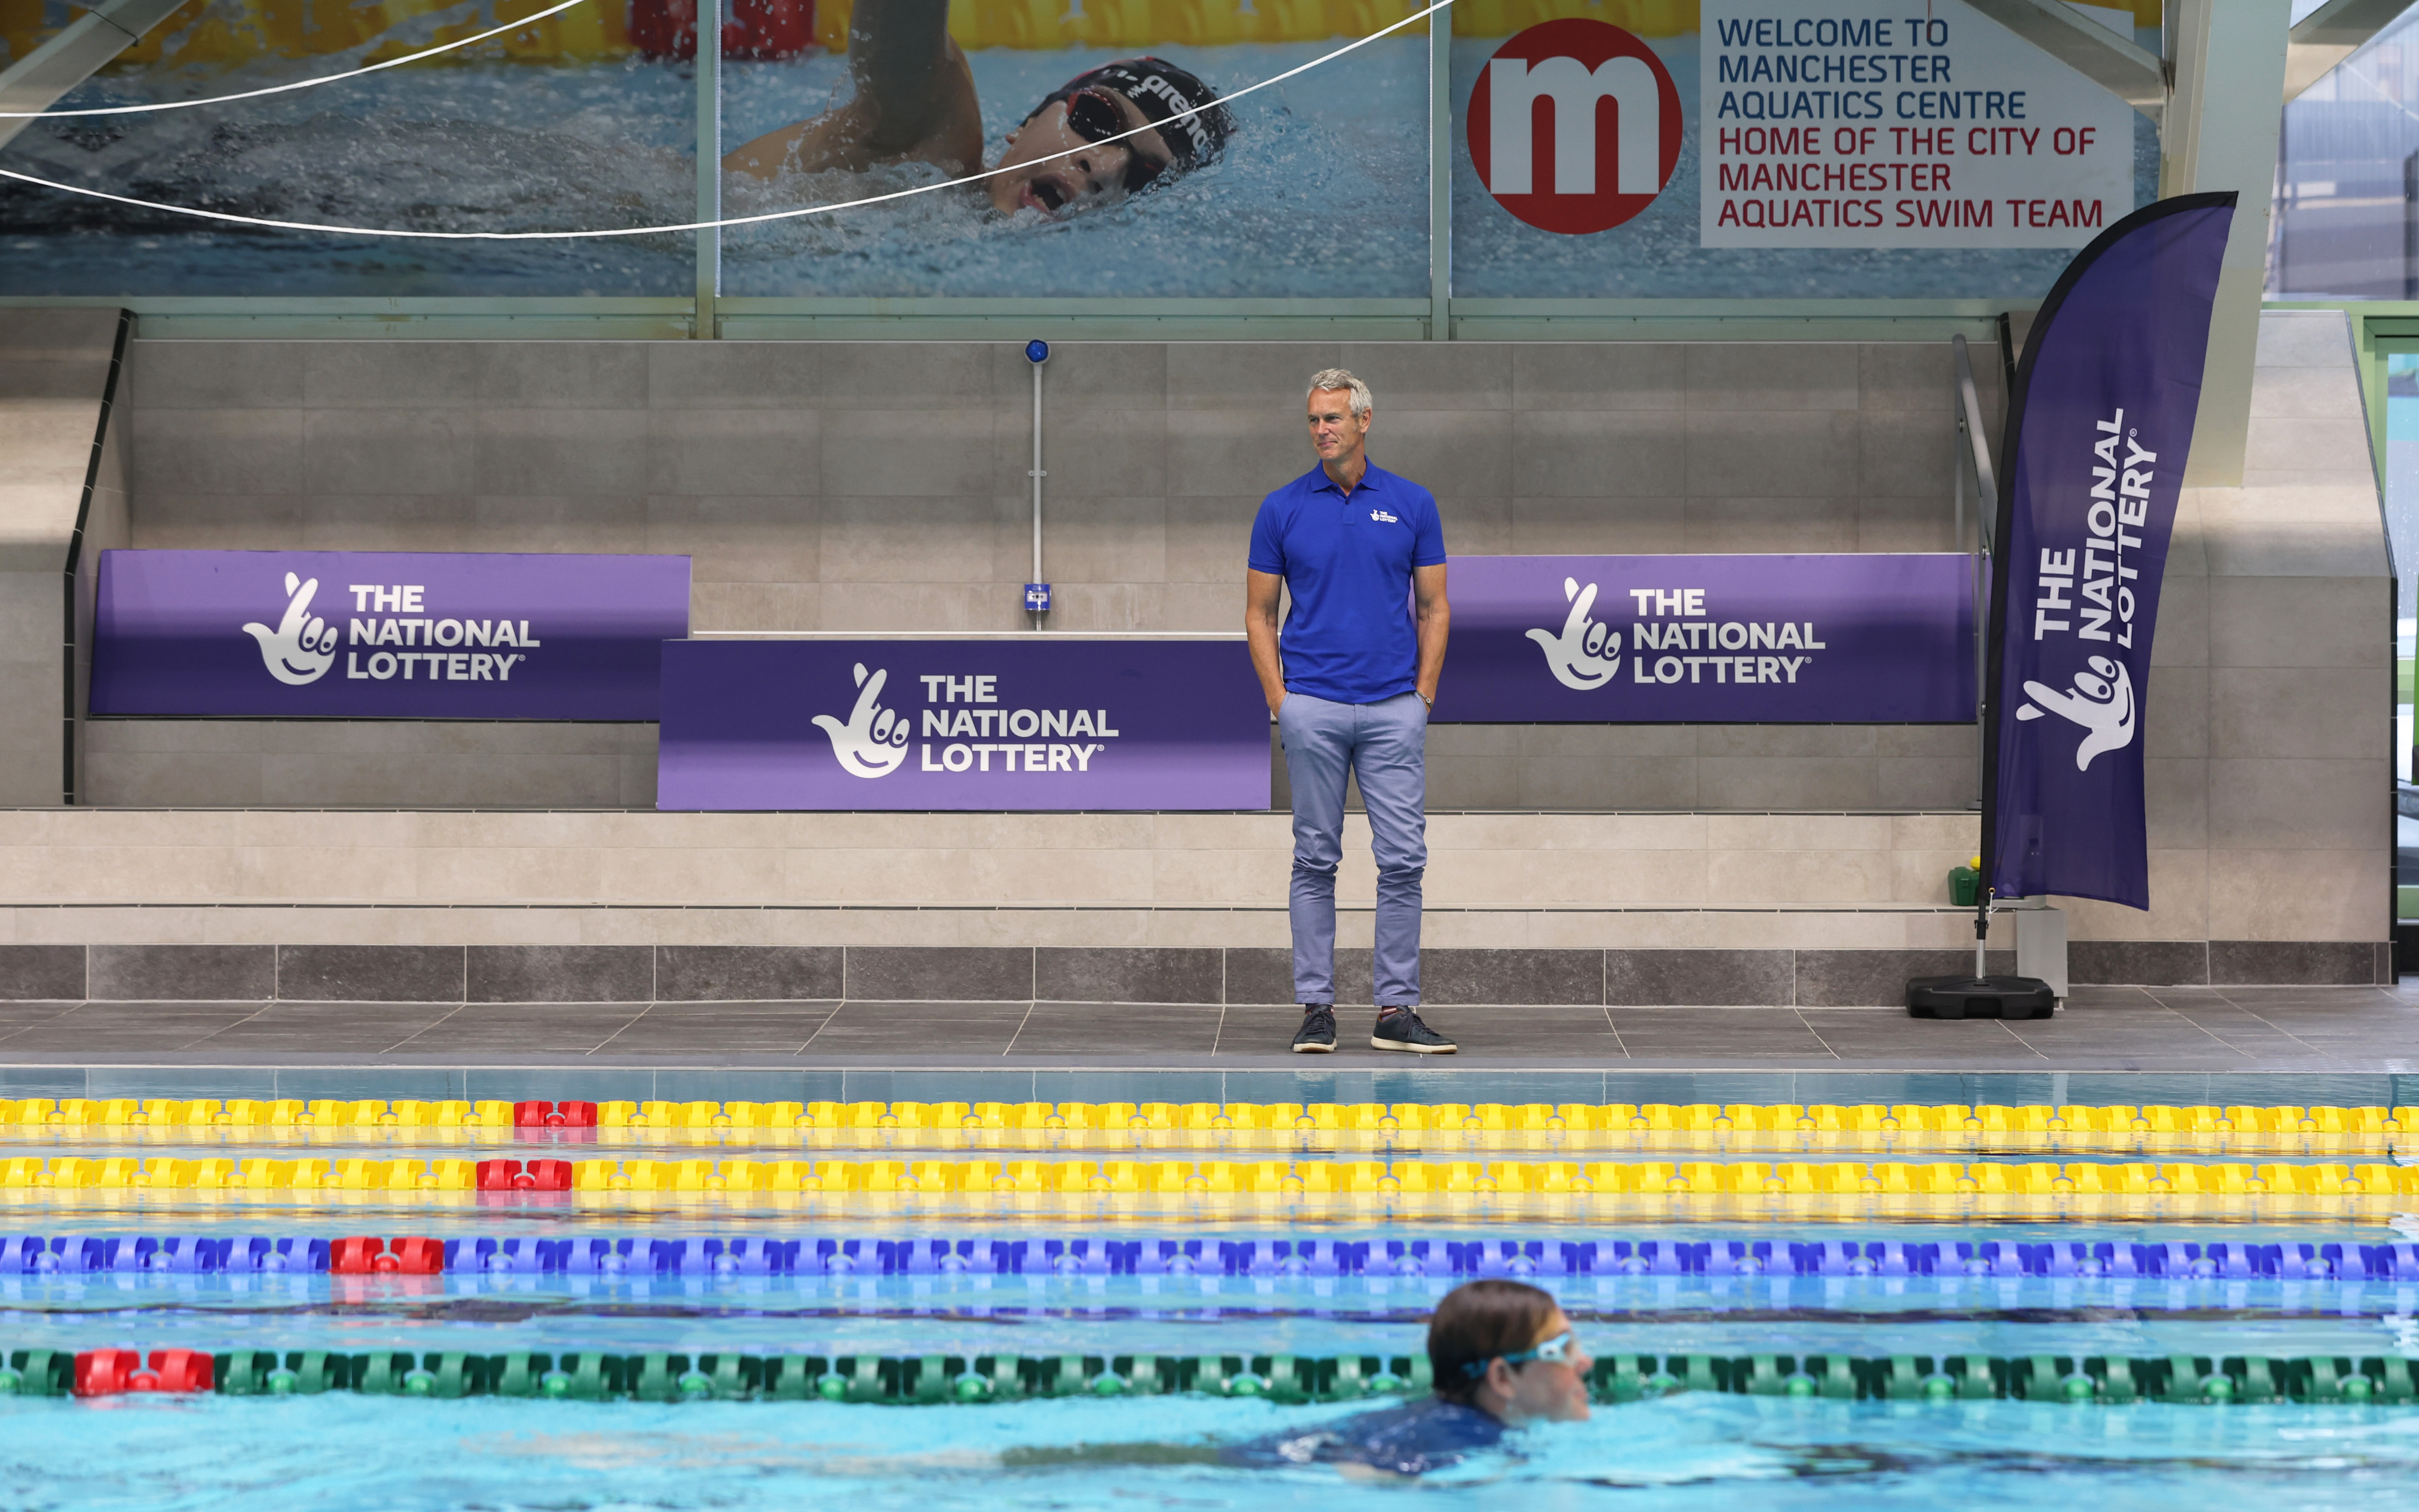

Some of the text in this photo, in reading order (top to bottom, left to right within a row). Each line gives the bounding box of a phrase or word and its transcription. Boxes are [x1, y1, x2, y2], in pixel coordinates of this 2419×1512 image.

[1717, 19, 1948, 47] WELCOME TO
[1719, 54, 1951, 83] MANCHESTER
[1143, 75, 1208, 151] arena
[1717, 91, 2026, 120] AQUATICS CENTRE
[1719, 126, 2097, 155] HOME OF THE CITY OF
[1719, 163, 1951, 191] MANCHESTER
[1717, 199, 2102, 229] AQUATICS SWIM TEAM
[2078, 408, 2124, 641] NATIONAL
[349, 584, 425, 612] THE
[1629, 589, 1706, 616] THE
[2035, 547, 2076, 640] THE
[349, 618, 541, 647] NATIONAL
[1633, 622, 1826, 650] NATIONAL
[920, 675, 998, 703] THE
[922, 709, 1119, 737] NATIONAL
